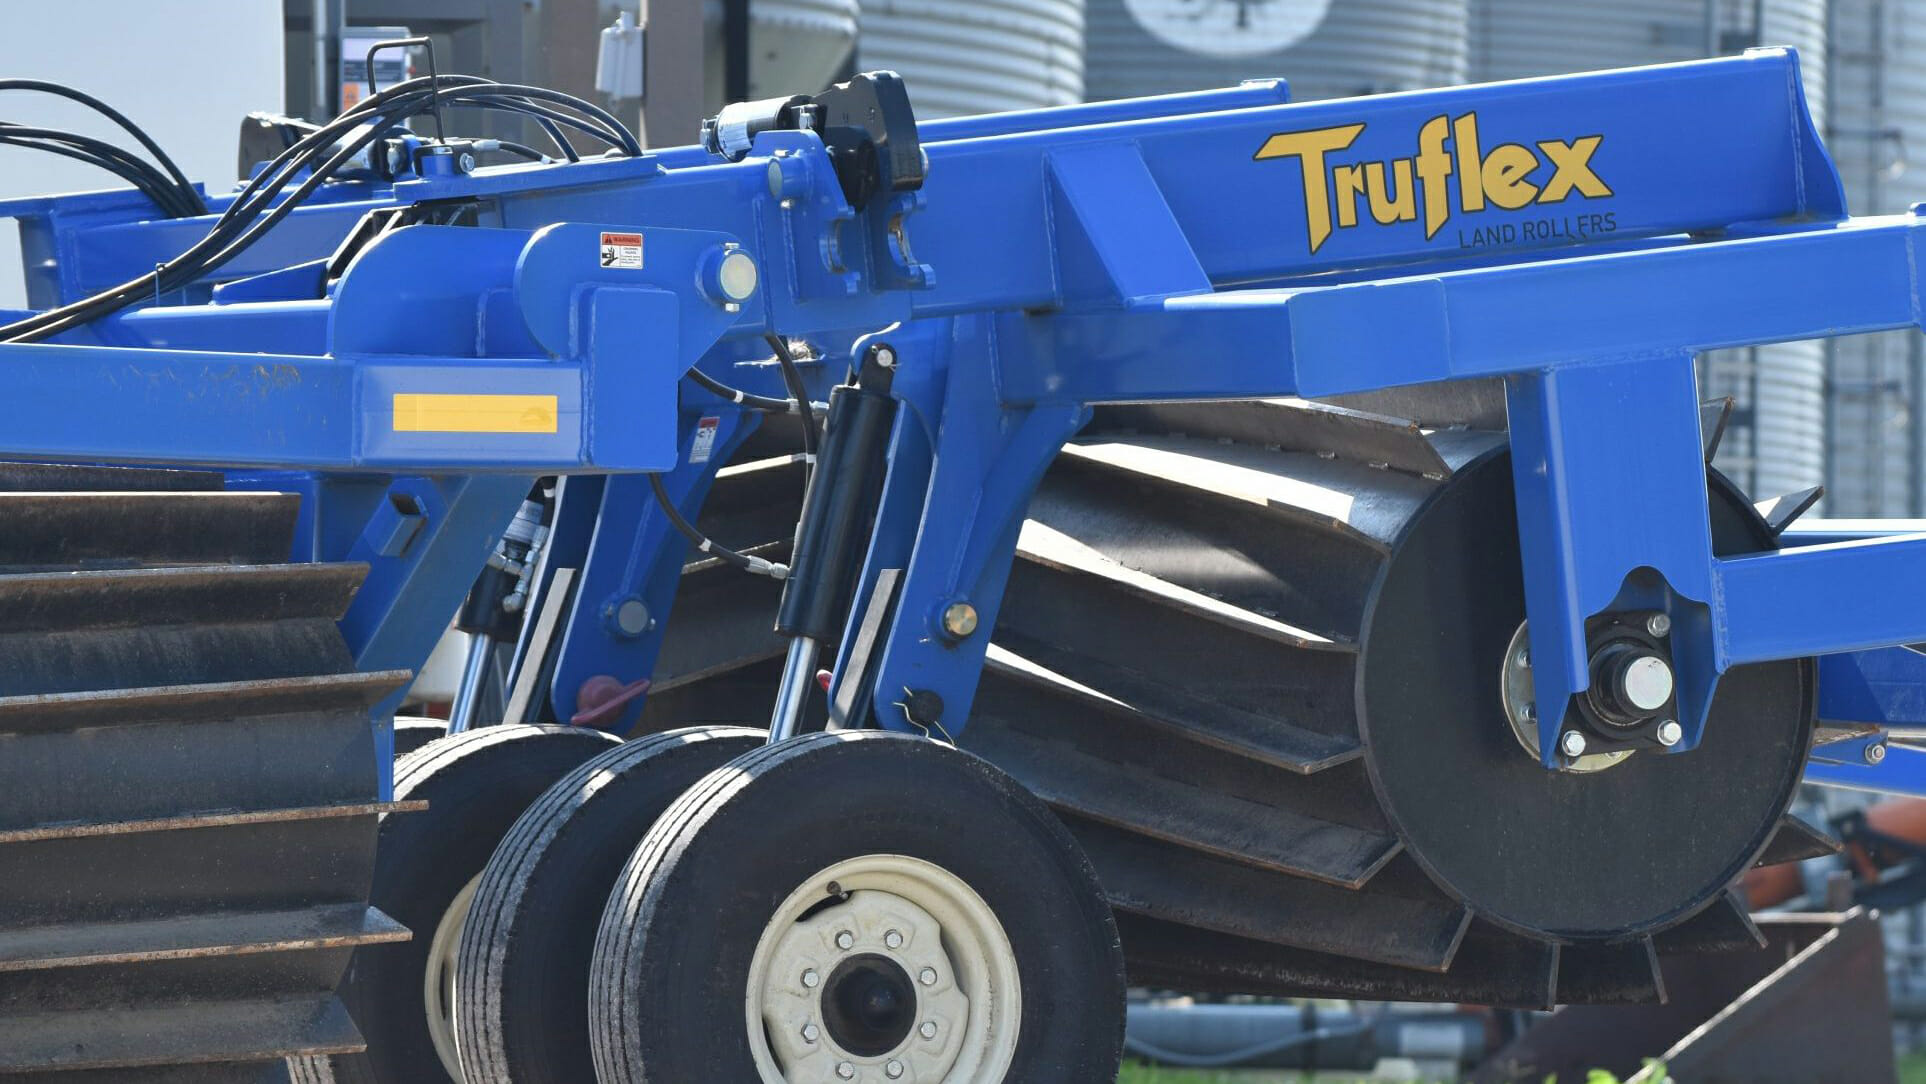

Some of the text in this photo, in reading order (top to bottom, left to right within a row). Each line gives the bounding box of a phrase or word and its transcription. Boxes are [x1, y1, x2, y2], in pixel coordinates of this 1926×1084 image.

[1253, 111, 1614, 255] Truflex
[1458, 212, 1617, 249] LAND ROLLERS
